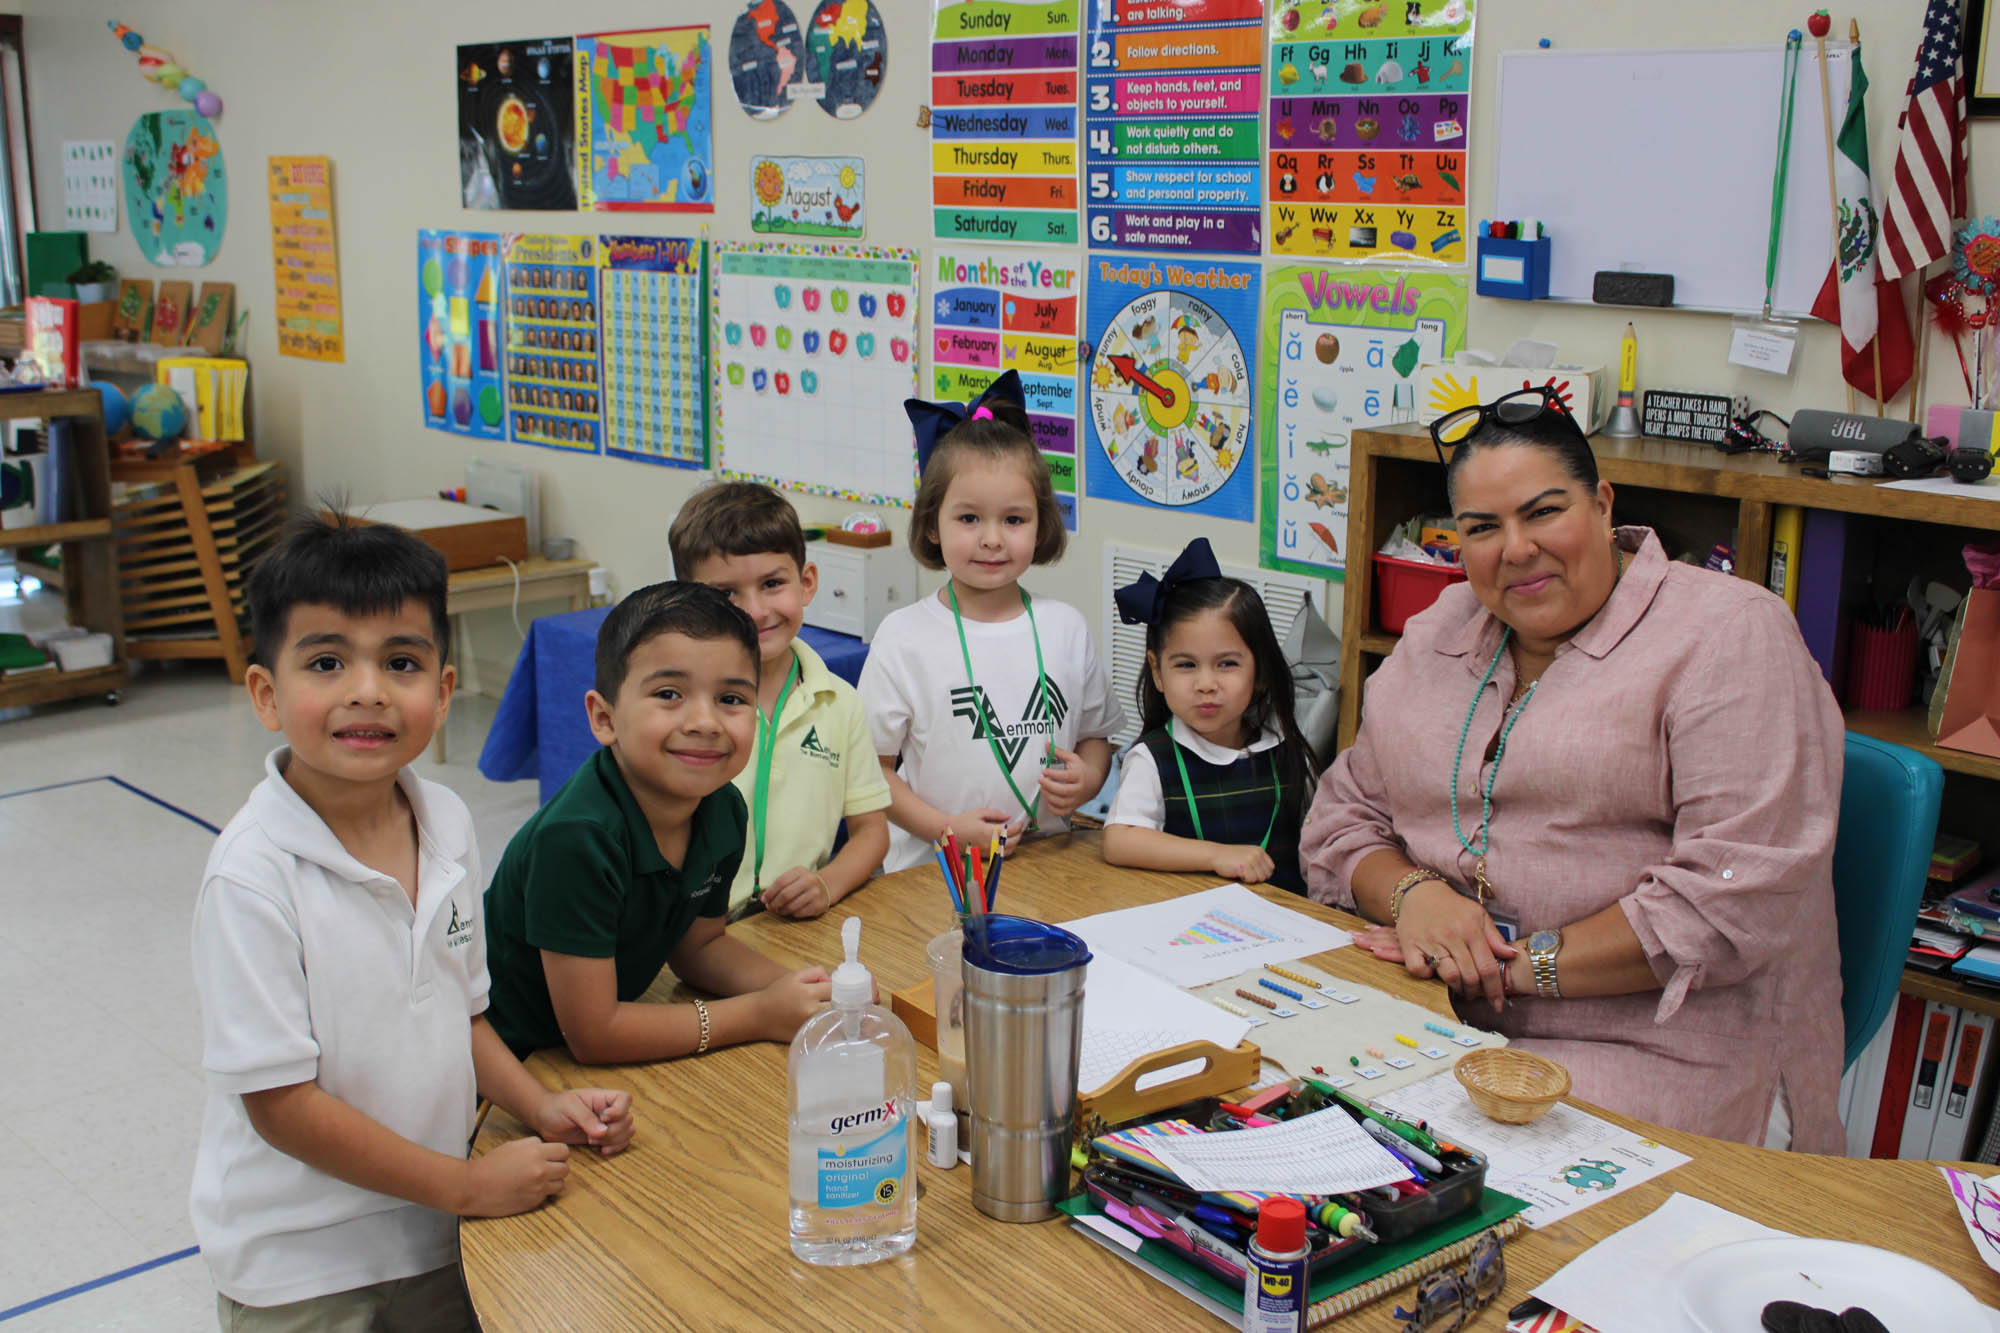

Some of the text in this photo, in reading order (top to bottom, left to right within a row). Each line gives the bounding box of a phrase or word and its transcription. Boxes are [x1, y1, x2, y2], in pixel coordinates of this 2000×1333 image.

[960, 11, 1011, 31] Sunday
[1047, 11, 1070, 24] Sun.
[1127, 6, 1187, 21] are talking.
[957, 45, 1014, 65] Monday
[1046, 48, 1070, 59] Mon.
[1091, 41, 1120, 67] 2.
[1127, 44, 1219, 58] Follow directions.
[1281, 46, 1294, 63] Ff
[1309, 46, 1330, 65] Gg
[1345, 44, 1366, 60] Hh
[1386, 42, 1398, 59] Ii
[1418, 41, 1430, 62] Jj
[580, 56, 589, 92] Map
[957, 80, 1014, 100] Tuesday
[1046, 82, 1070, 95] Tues.
[1127, 79, 1241, 95] Keep hands, feet, and
[1091, 86, 1119, 111] 3.
[1127, 96, 1228, 112] objects to yourself.
[1281, 98, 1458, 117] Ll Mm Nn Oo Pp
[580, 97, 589, 147] States
[944, 115, 1028, 135] Wednesday
[1045, 119, 1070, 130] Wed.
[1127, 125, 1233, 140] Work quietly and do
[1090, 130, 1119, 155] 4.
[1127, 142, 1221, 155] not disturb others.
[954, 148, 1018, 169] Thursday
[1043, 153, 1072, 165] Thurs.
[1277, 154, 1457, 173] Qq Rr Ss Tt Uu
[1091, 173, 1119, 199] 5.
[1126, 171, 1251, 185] Show respect for school
[785, 187, 833, 213] August
[963, 180, 1006, 202] Friday
[1050, 185, 1064, 198] Fri.
[1126, 188, 1248, 203] and personal property.
[954, 215, 1017, 236] Saturday
[1126, 214, 1224, 231] Work and play in a
[1279, 207, 1455, 229] Vv Ww Xx Yy Zz
[1047, 222, 1067, 235] Sat.
[1091, 216, 1118, 242] 6.
[1125, 231, 1191, 245] safe manner.
[939, 256, 1075, 289] Months of the Year
[1100, 263, 1252, 290] Today's Weather
[1298, 271, 1420, 315] Vowels
[953, 297, 996, 317] January
[1034, 303, 1058, 320] July
[1131, 297, 1157, 316] foggy
[1188, 300, 1212, 322] rainy
[1285, 311, 1303, 320] short
[1421, 322, 1438, 332] long
[953, 335, 997, 355] February
[1025, 341, 1066, 360] August
[1098, 328, 1118, 359] sunny
[1231, 353, 1244, 381] cold
[959, 374, 991, 389] March
[1023, 382, 1072, 398] eptember
[1646, 394, 1652, 407] A
[1653, 395, 1680, 410] TEACHER
[1682, 398, 1702, 412] TAKES
[1703, 400, 1708, 412] A
[1095, 396, 1106, 432] windy
[1646, 408, 1667, 421] OPENS
[1667, 410, 1672, 422] A
[1694, 413, 1721, 427] TOUCHES
[1722, 416, 1727, 428] A
[1031, 421, 1069, 437] ctober
[1236, 423, 1246, 445] hot
[1666, 424, 1690, 438] SHAPES
[1691, 426, 1702, 440] THE
[1832, 418, 1866, 440] JBL
[1126, 470, 1154, 495] cloudy
[1182, 483, 1210, 500] snowy
[831, 1099, 897, 1135] germ-X
[825, 1153, 893, 1169] moisturizing
[826, 1172, 869, 1183] original
[826, 1191, 859, 1199] sanitizer
[883, 1186, 892, 1197] 15
[1264, 1275, 1289, 1287] WD-40
